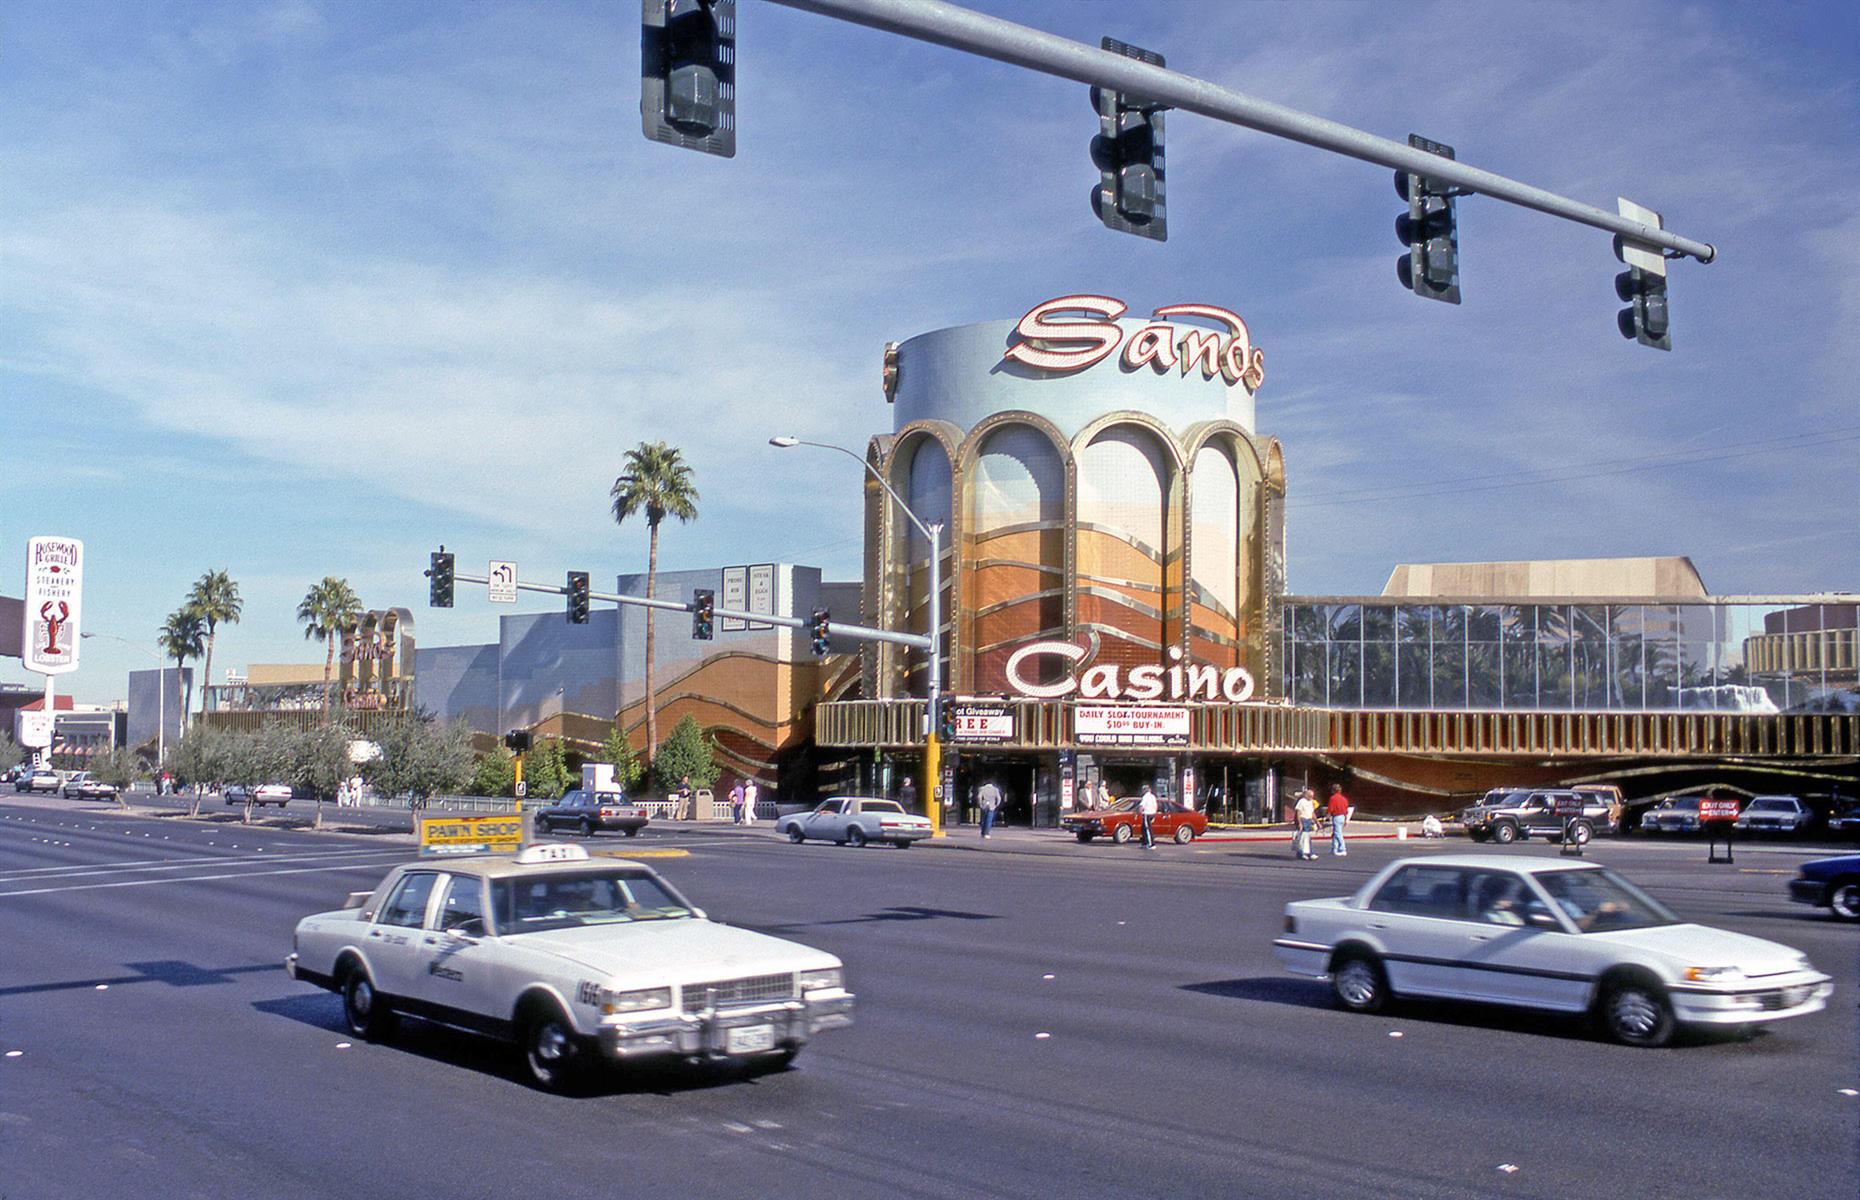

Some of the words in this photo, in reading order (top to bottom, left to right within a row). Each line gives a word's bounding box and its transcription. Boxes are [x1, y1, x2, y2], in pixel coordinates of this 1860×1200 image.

[1004, 294, 1265, 388] Sands
[35, 542, 77, 566] ROSEWOOD
[45, 554, 69, 565] GRILLE
[1005, 638, 1254, 702] Casino
[966, 707, 1005, 716] Giveaway
[1080, 711, 1104, 719] DAILY
[1131, 711, 1185, 719] TOURNAMENT
[428, 825, 472, 837] PAWN
[477, 823, 520, 836] SHOP
